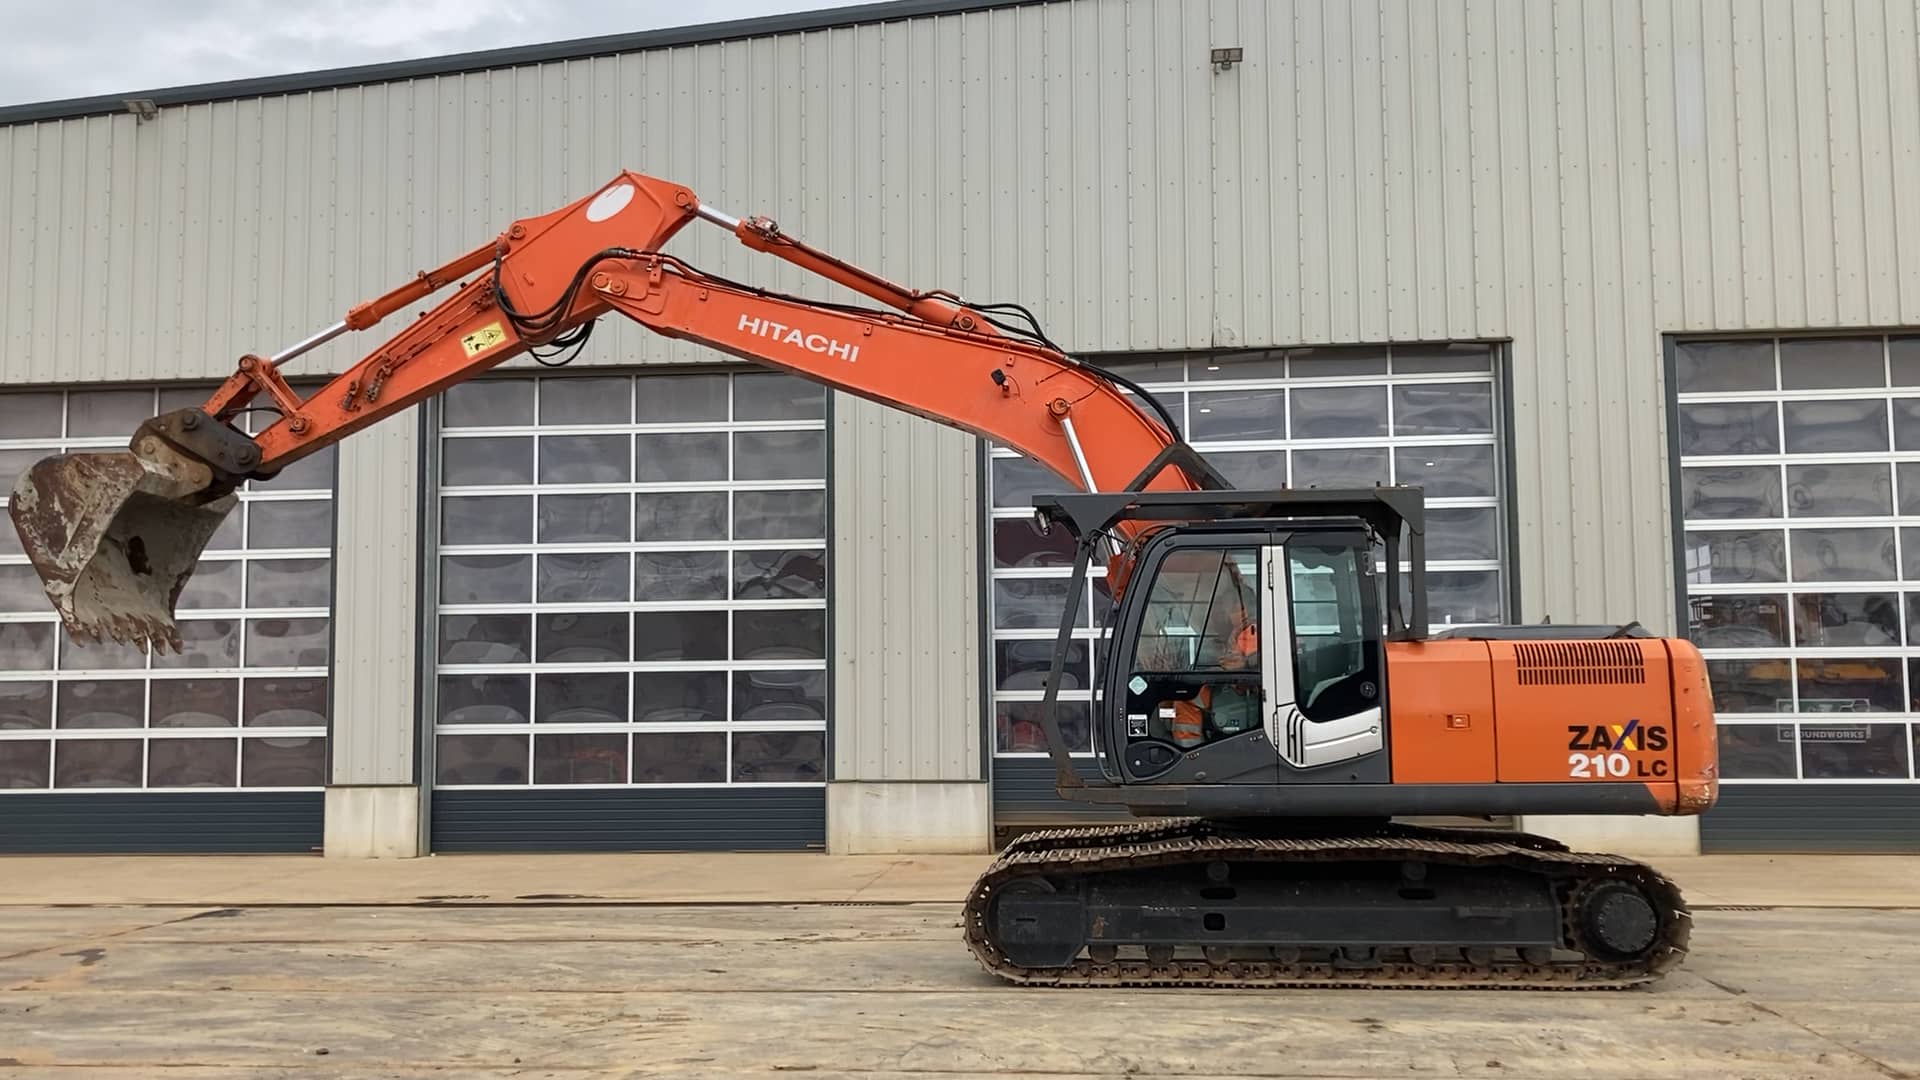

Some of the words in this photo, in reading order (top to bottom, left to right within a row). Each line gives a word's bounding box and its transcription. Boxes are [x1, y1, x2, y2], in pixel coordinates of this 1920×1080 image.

[737, 314, 860, 363] HITACHI
[1568, 719, 1668, 751] ZAXIS
[1783, 730, 1865, 739] GOUNDWORKS
[1568, 753, 1631, 778] 210
[1637, 760, 1668, 777] LC
